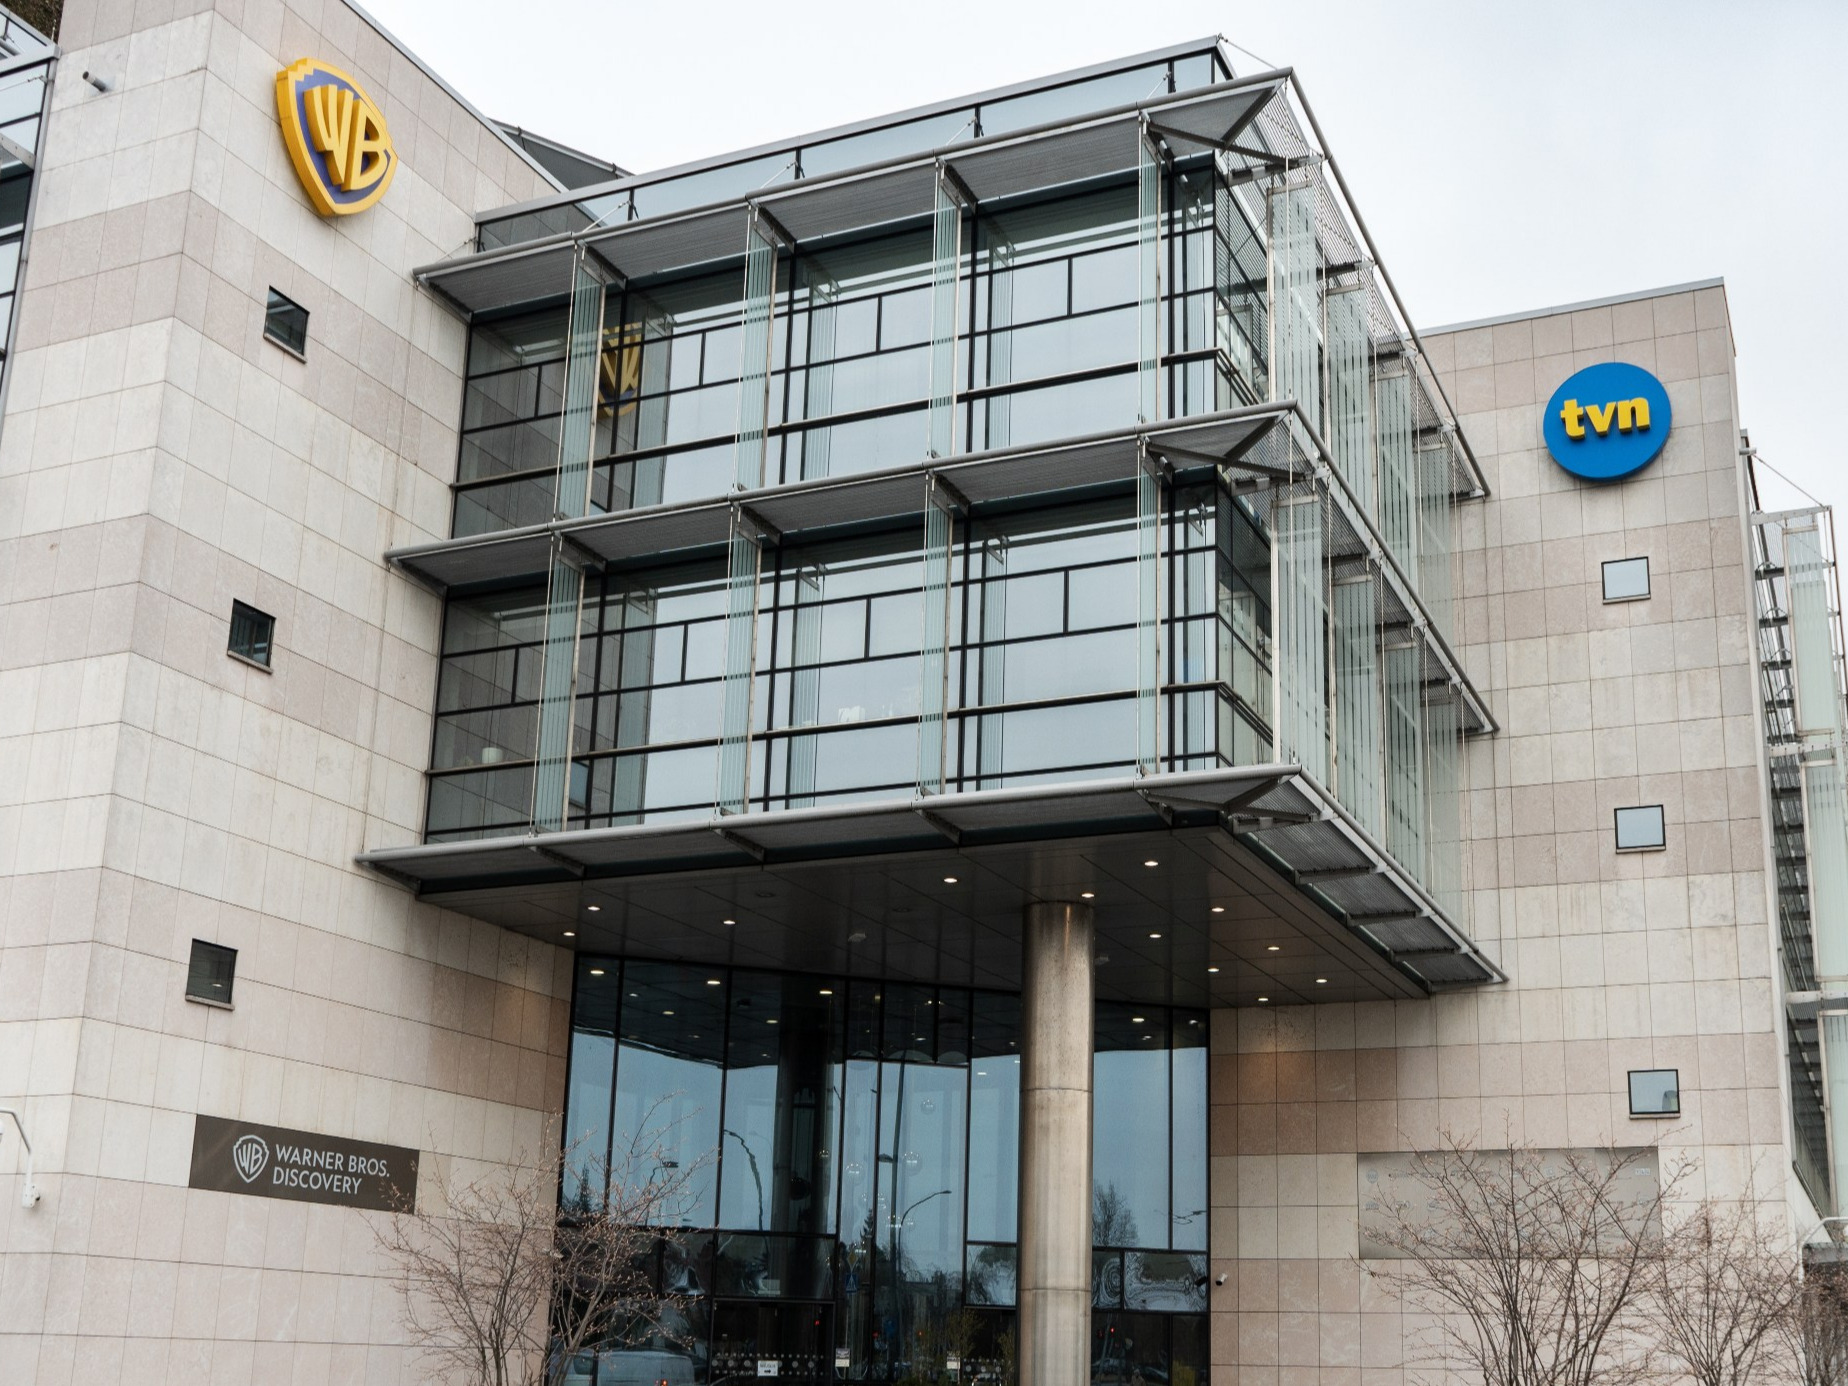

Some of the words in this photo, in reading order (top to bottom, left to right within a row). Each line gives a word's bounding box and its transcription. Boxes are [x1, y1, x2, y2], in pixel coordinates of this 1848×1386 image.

[303, 83, 389, 193] WB
[1560, 396, 1650, 440] tvn
[238, 1142, 263, 1175] WB
[275, 1143, 343, 1171] WARNER
[348, 1155, 390, 1177] BROS.
[272, 1166, 362, 1194] DISCOVERY
